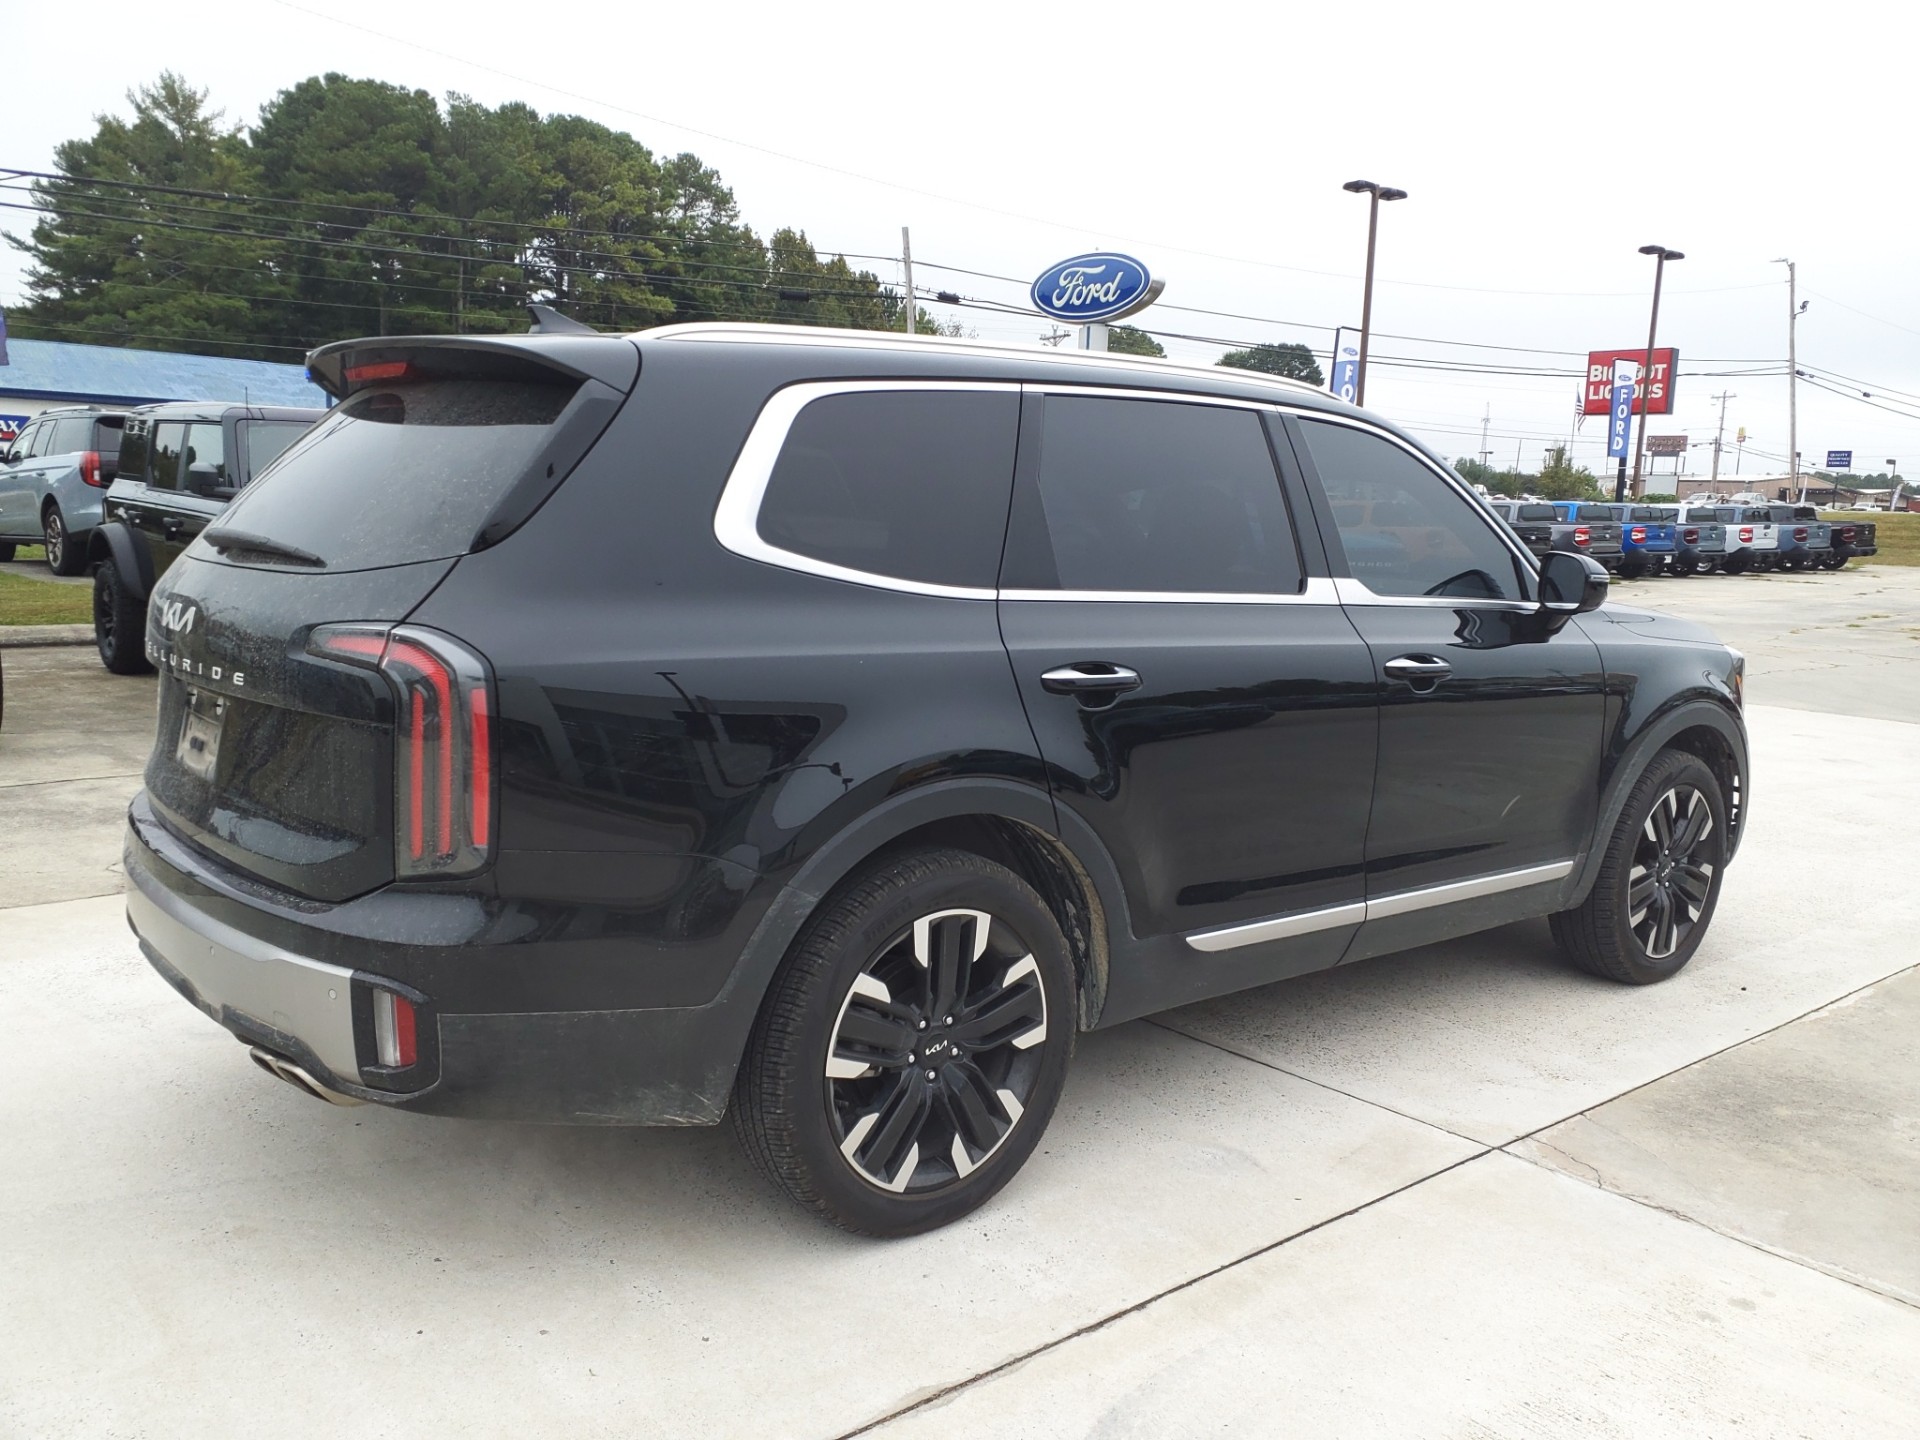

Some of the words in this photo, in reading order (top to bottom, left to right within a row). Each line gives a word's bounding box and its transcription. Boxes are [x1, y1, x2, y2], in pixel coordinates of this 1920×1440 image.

[1052, 264, 1124, 308] Ford
[1588, 382, 1664, 400] LIQORS
[1589, 363, 1667, 382] BIOOT
[1612, 389, 1630, 451] FORD
[146, 641, 245, 686] ELLURIDE
